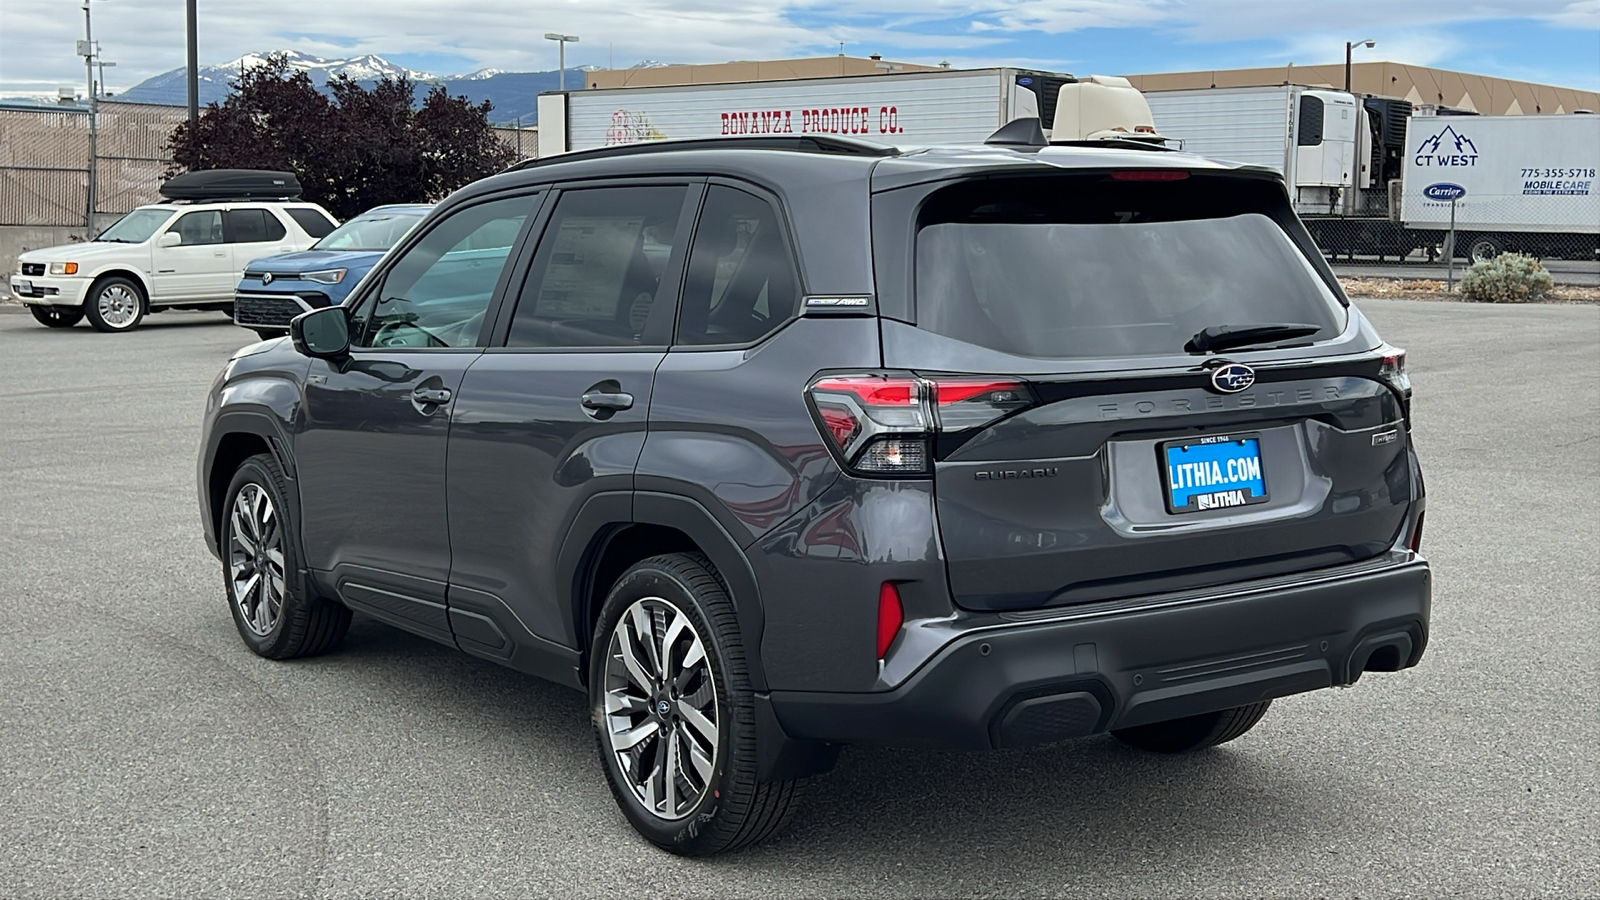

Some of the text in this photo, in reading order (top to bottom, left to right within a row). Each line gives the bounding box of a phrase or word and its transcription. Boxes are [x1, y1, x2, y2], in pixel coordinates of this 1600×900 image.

[721, 106, 903, 135] BONANZA PRODUCE CO.
[1415, 155, 1478, 166] CT WEST
[1521, 168, 1596, 178] 775-355-5718
[1428, 187, 1461, 196] Carrier
[836, 298, 867, 306] AWD
[1097, 386, 1341, 420] FORESTER
[1200, 436, 1217, 444] SINCE
[974, 467, 1058, 480] SUBARU
[1169, 456, 1261, 489] LITHIA.COM
[1208, 490, 1246, 508] LITHIA
